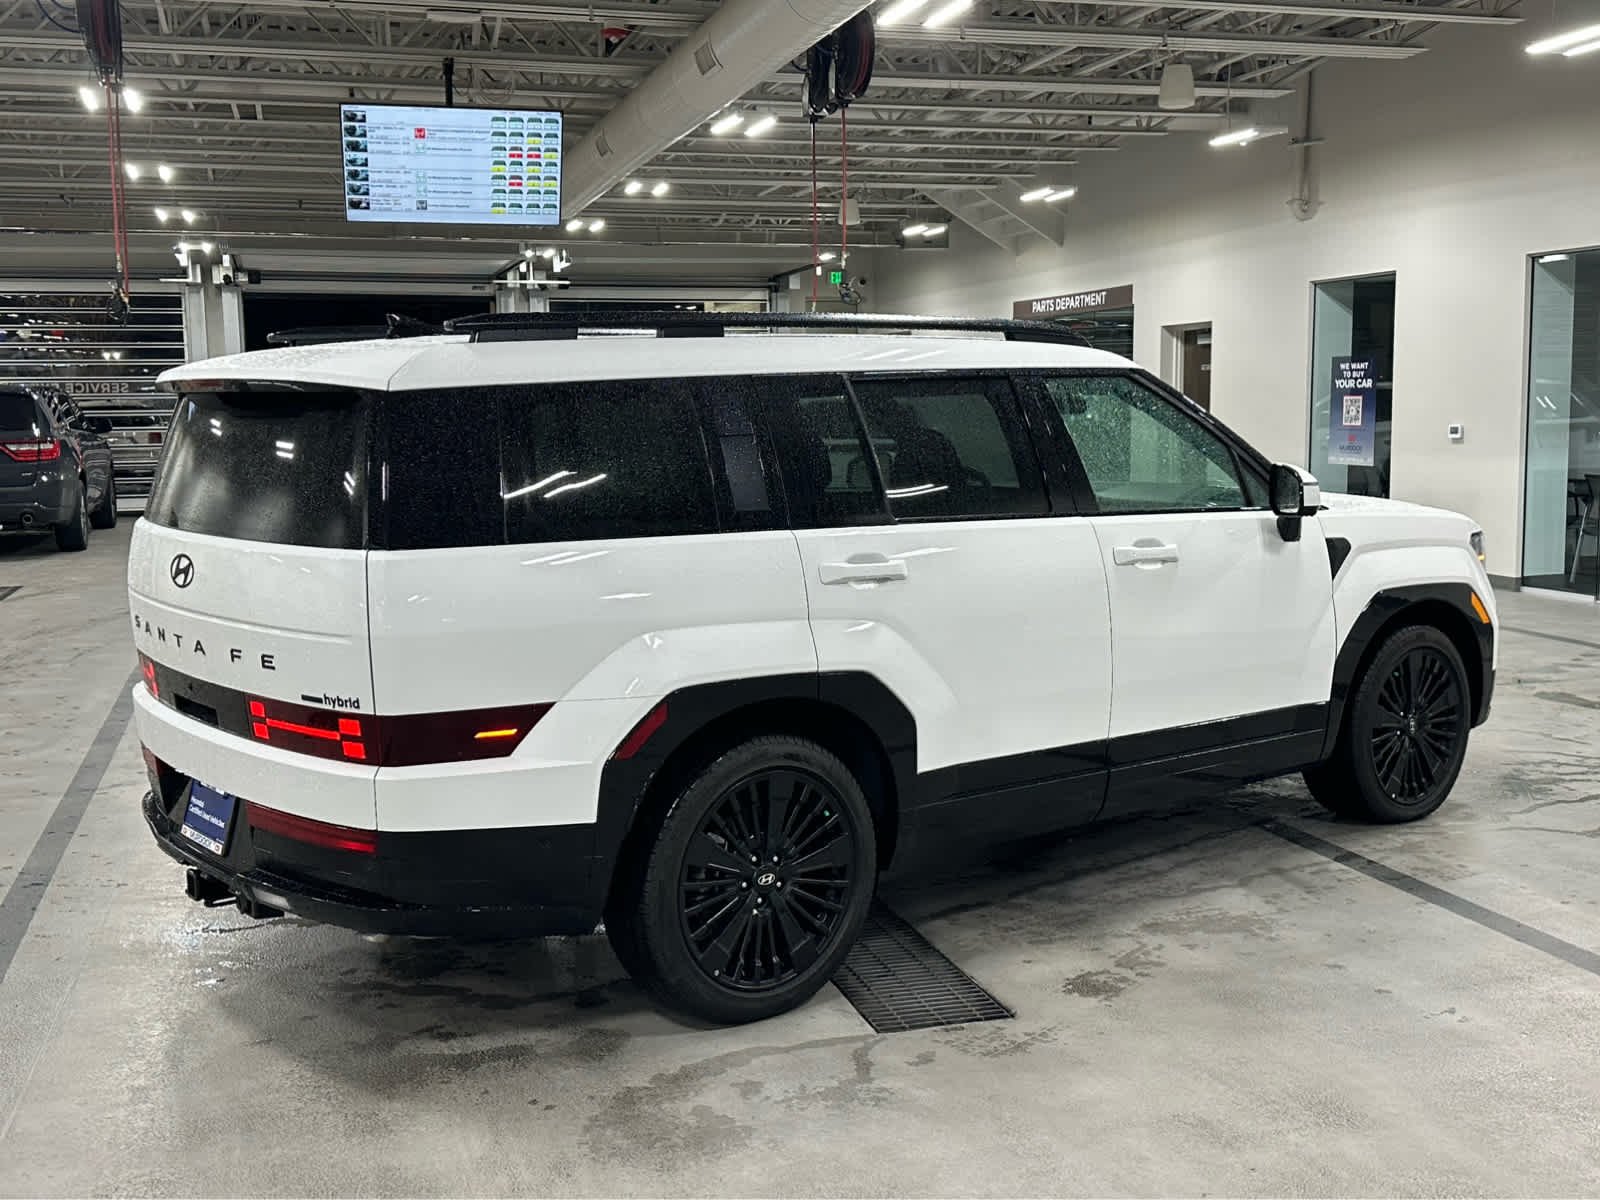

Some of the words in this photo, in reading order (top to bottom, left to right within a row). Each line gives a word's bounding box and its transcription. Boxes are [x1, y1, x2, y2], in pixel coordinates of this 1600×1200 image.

[1032, 299, 1055, 313] PARTS
[1056, 292, 1106, 310] DEPARTMENT
[1351, 362, 1368, 370] WANT
[1335, 379, 1355, 389] YOUR
[1356, 379, 1373, 389] CAR
[134, 614, 206, 656] SANTA
[230, 648, 276, 670] FE
[323, 693, 360, 710] hybrid
